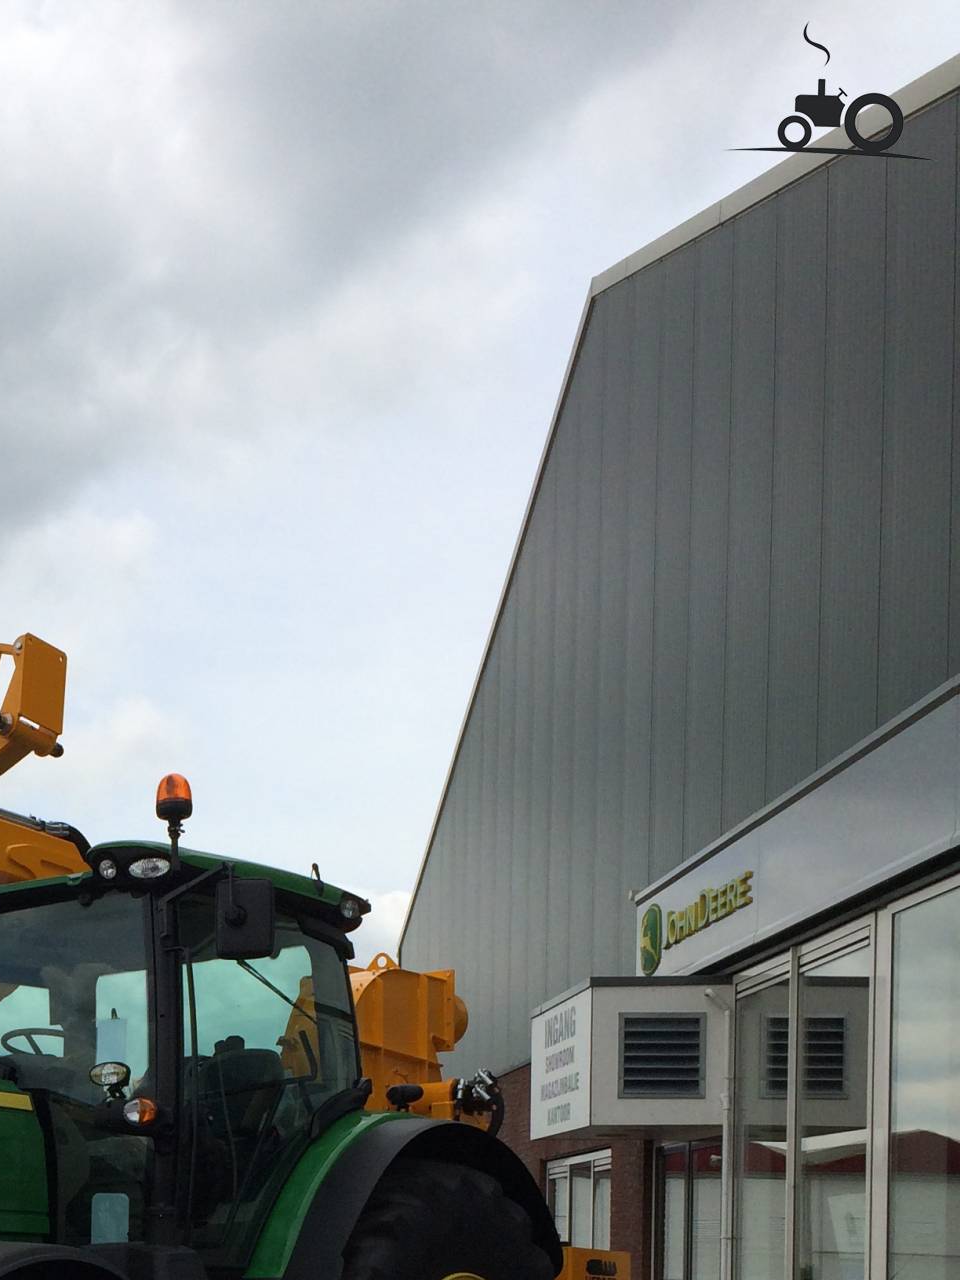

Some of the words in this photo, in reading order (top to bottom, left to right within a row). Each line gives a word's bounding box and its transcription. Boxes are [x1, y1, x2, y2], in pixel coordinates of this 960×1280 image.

[661, 902, 698, 950] JOHN
[698, 871, 753, 929] DEERE
[545, 1006, 576, 1049] INGANG
[545, 1045, 575, 1074] SHOWROOM
